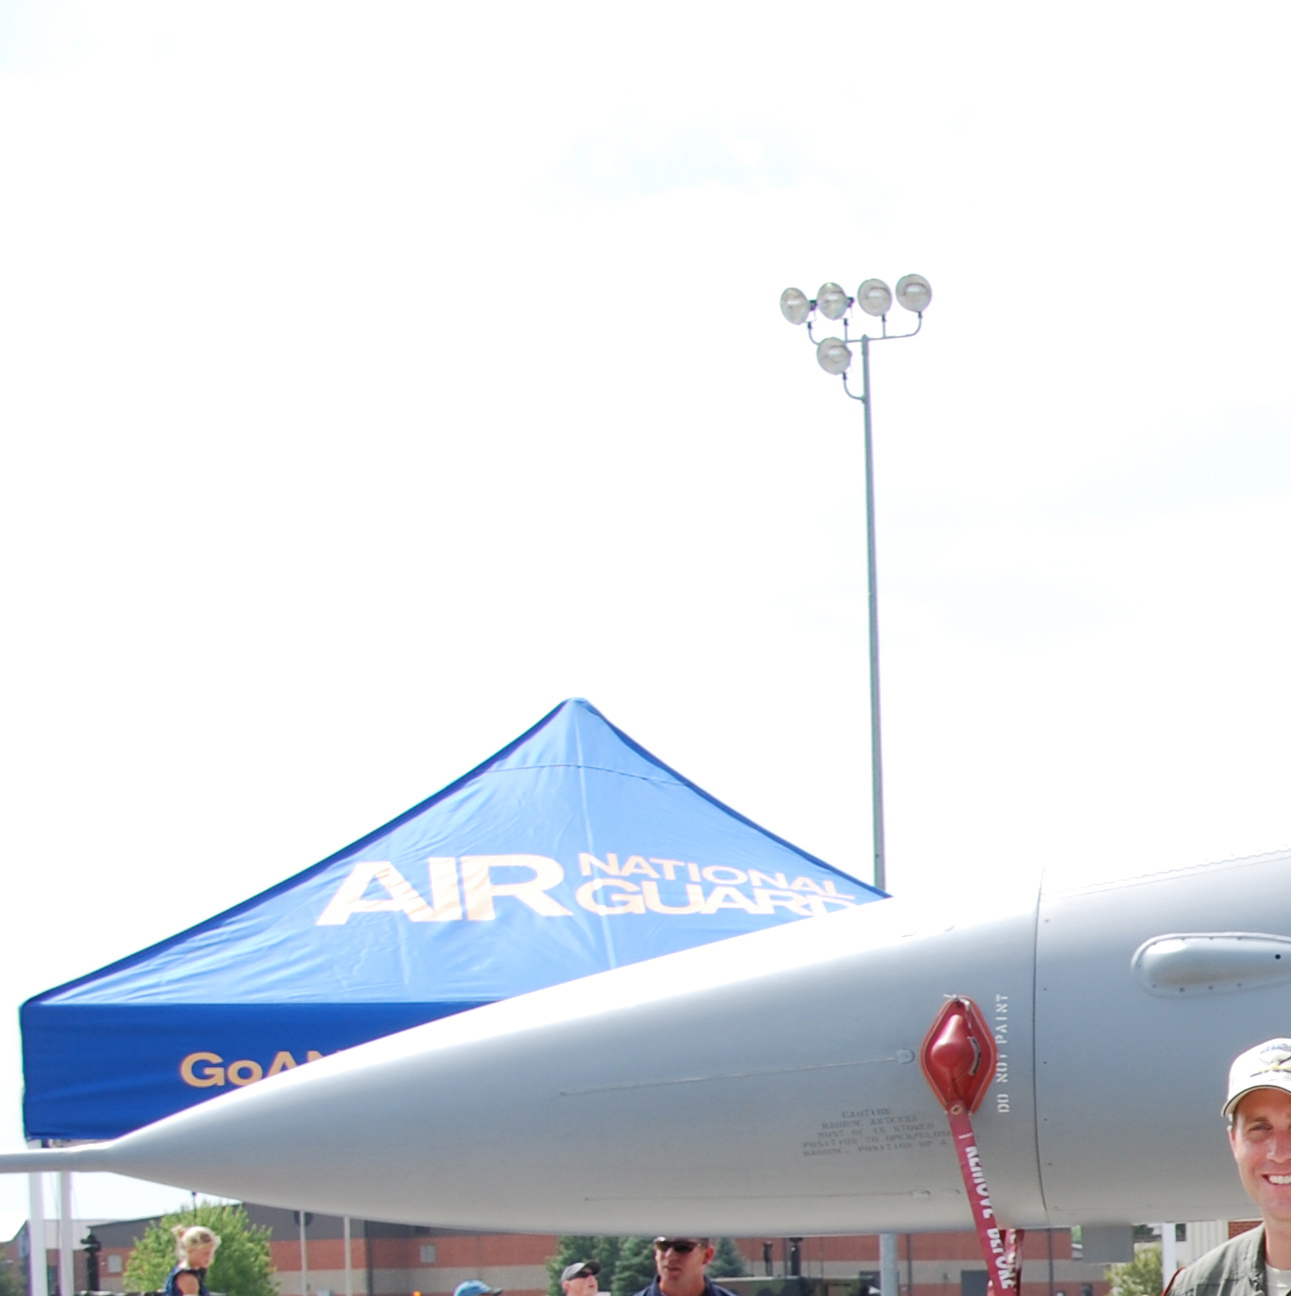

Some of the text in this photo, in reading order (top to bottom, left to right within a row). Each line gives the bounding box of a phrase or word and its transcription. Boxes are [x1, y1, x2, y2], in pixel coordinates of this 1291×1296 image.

[315, 853, 574, 926] AIR
[578, 853, 856, 900] NATIONAL
[995, 994, 1009, 1044] PAINT
[180, 1050, 330, 1088] GoA
[997, 1093, 1010, 1113] DO
